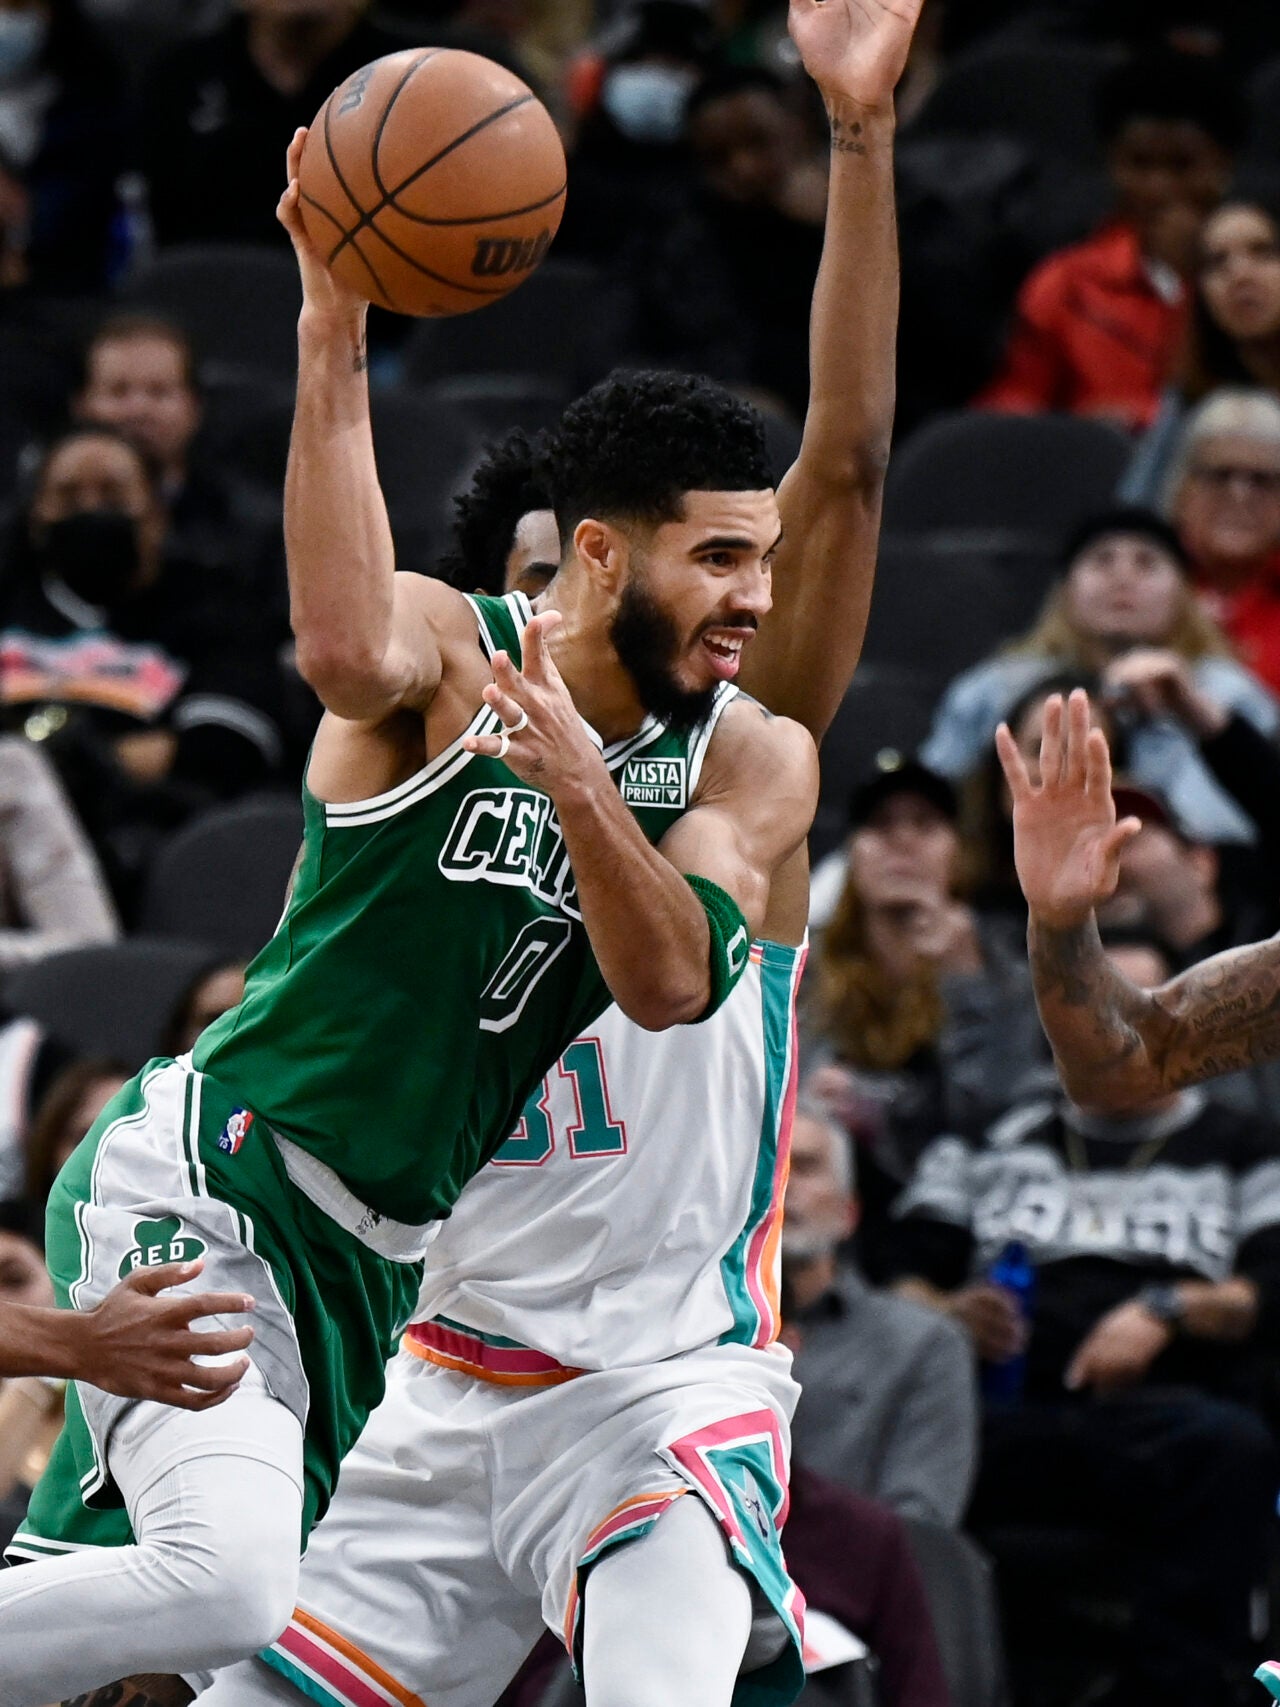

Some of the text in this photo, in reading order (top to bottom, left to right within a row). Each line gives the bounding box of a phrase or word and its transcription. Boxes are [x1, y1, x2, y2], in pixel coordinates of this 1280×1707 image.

[627, 761, 680, 785] VISTA
[626, 786, 661, 802] PRINT
[478, 915, 572, 1034] 0
[130, 1241, 185, 1269] RED
